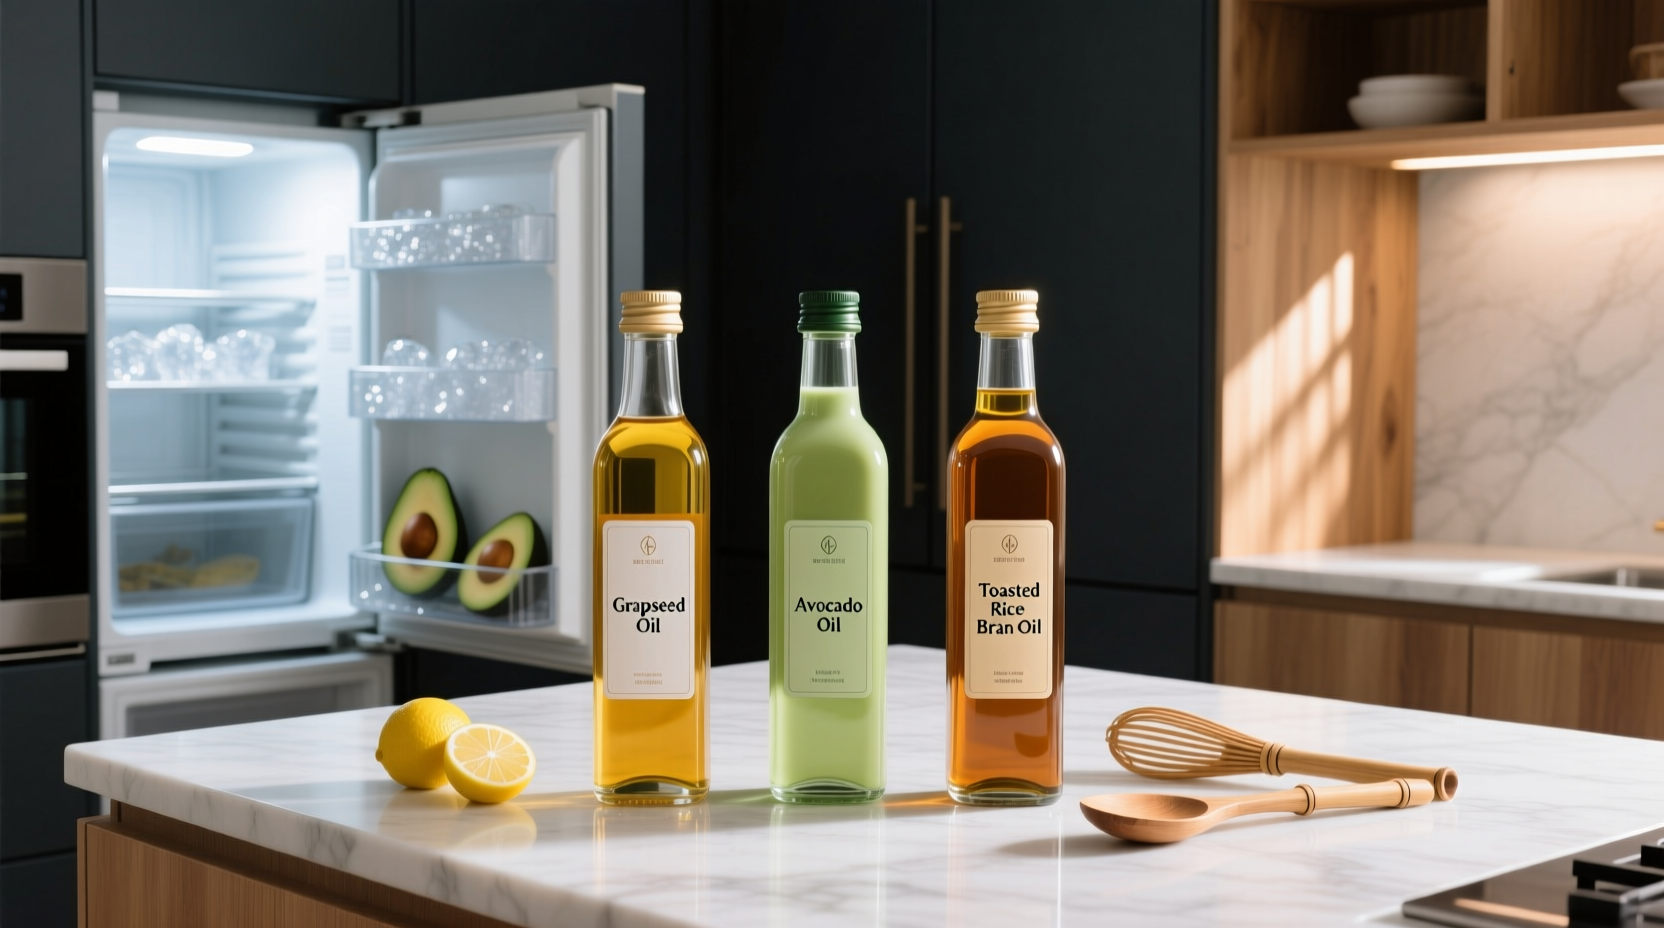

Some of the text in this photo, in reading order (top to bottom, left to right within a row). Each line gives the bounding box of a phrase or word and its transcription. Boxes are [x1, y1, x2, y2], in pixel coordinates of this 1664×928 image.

[978, 582, 1040, 598] Toasted
[612, 597, 686, 617] Grapseed
[794, 597, 863, 613] Avocado
[991, 602, 1025, 616] Rice
[636, 617, 661, 633] Oil
[817, 617, 841, 632] Oil
[977, 619, 1042, 634] Bran Oil
